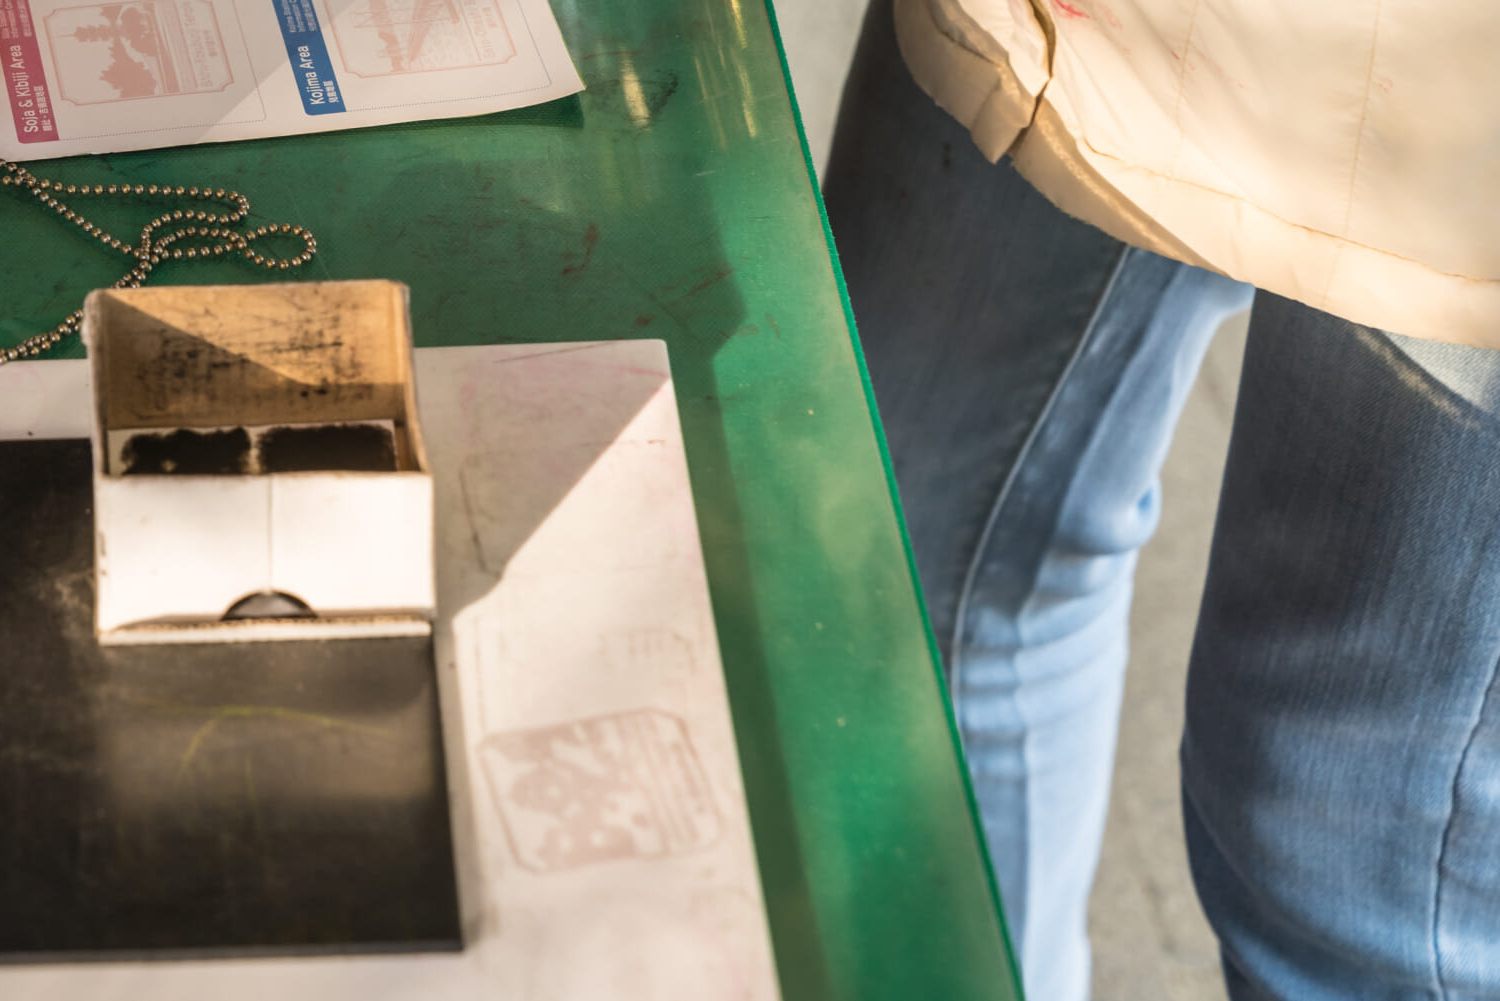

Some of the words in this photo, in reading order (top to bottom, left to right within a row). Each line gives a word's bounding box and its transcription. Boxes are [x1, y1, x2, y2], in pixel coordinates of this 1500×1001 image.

[10, 45, 25, 69] Area
[298, 45, 314, 69] Area
[12, 73, 31, 98] Kibiji
[305, 71, 325, 105] Kojima
[18, 99, 33, 108] &
[22, 107, 38, 133] Soja
